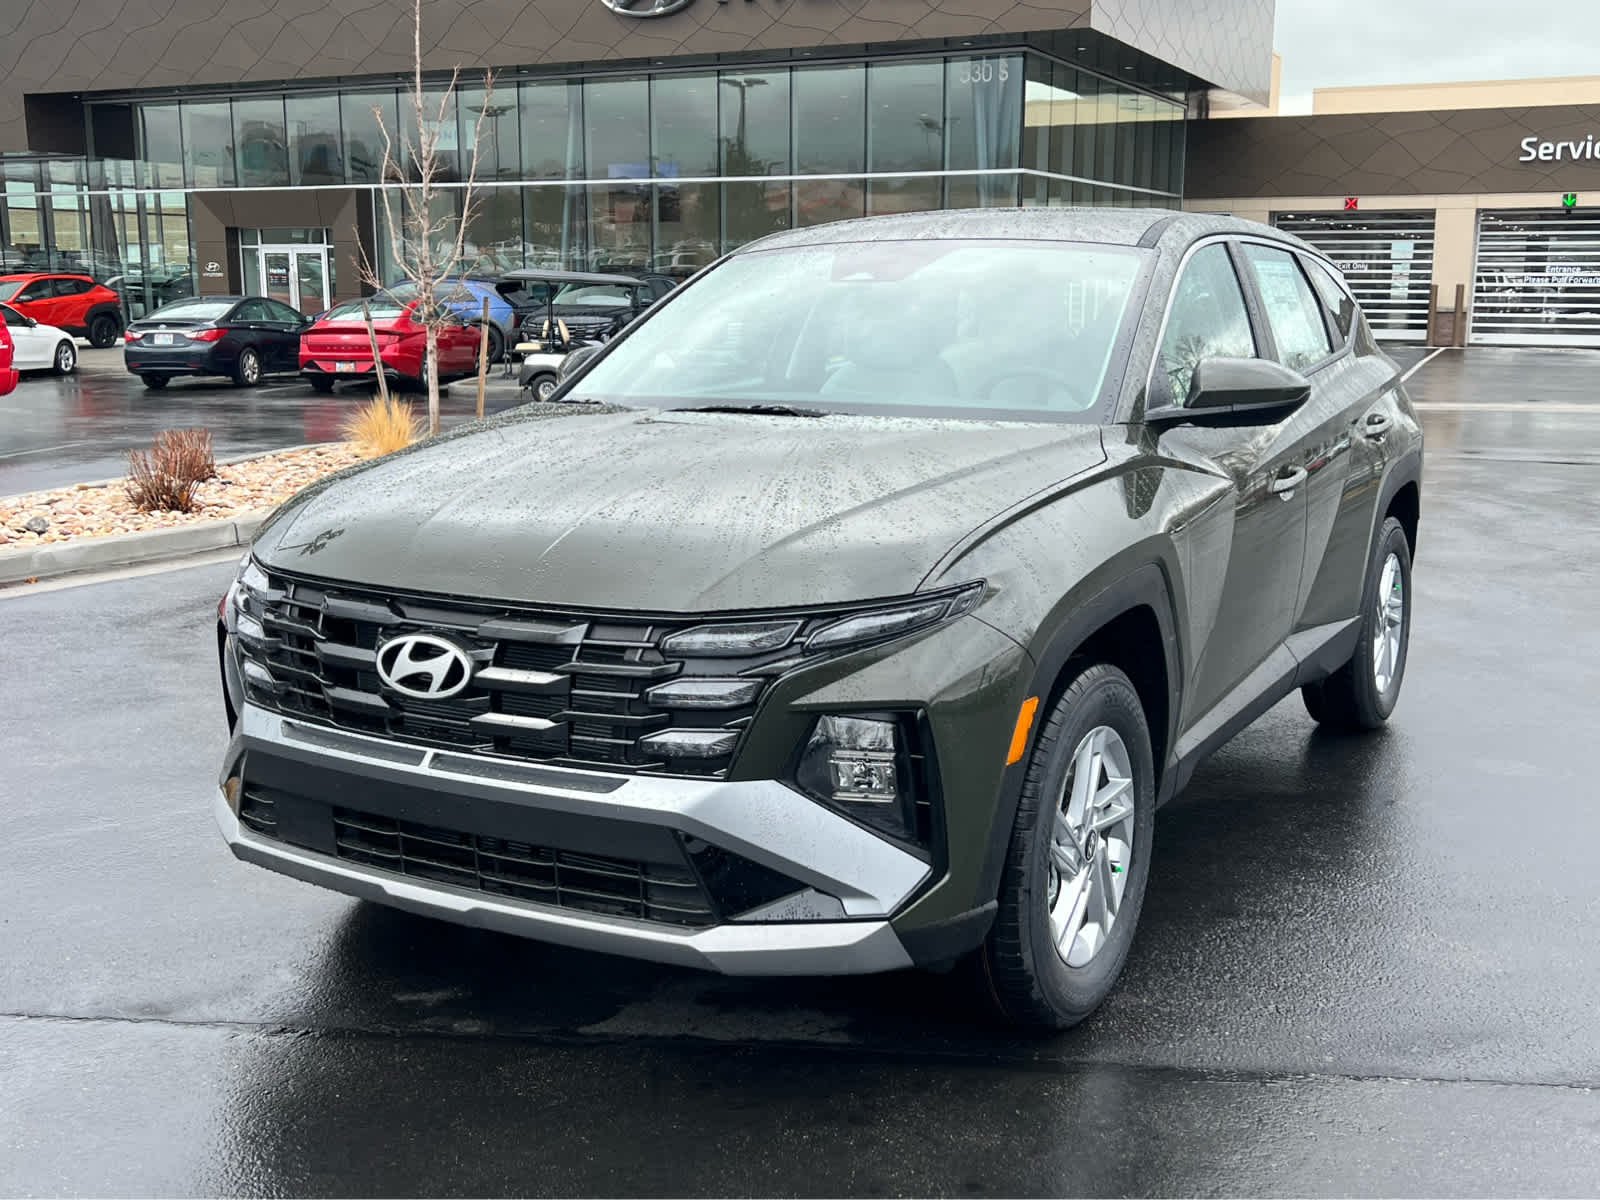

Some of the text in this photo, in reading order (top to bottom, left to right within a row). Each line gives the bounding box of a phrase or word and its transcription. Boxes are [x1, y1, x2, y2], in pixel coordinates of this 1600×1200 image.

[1338, 261, 1369, 272] Exit Only
[1545, 265, 1582, 275] Entrance
[1524, 275, 1550, 285] Please
